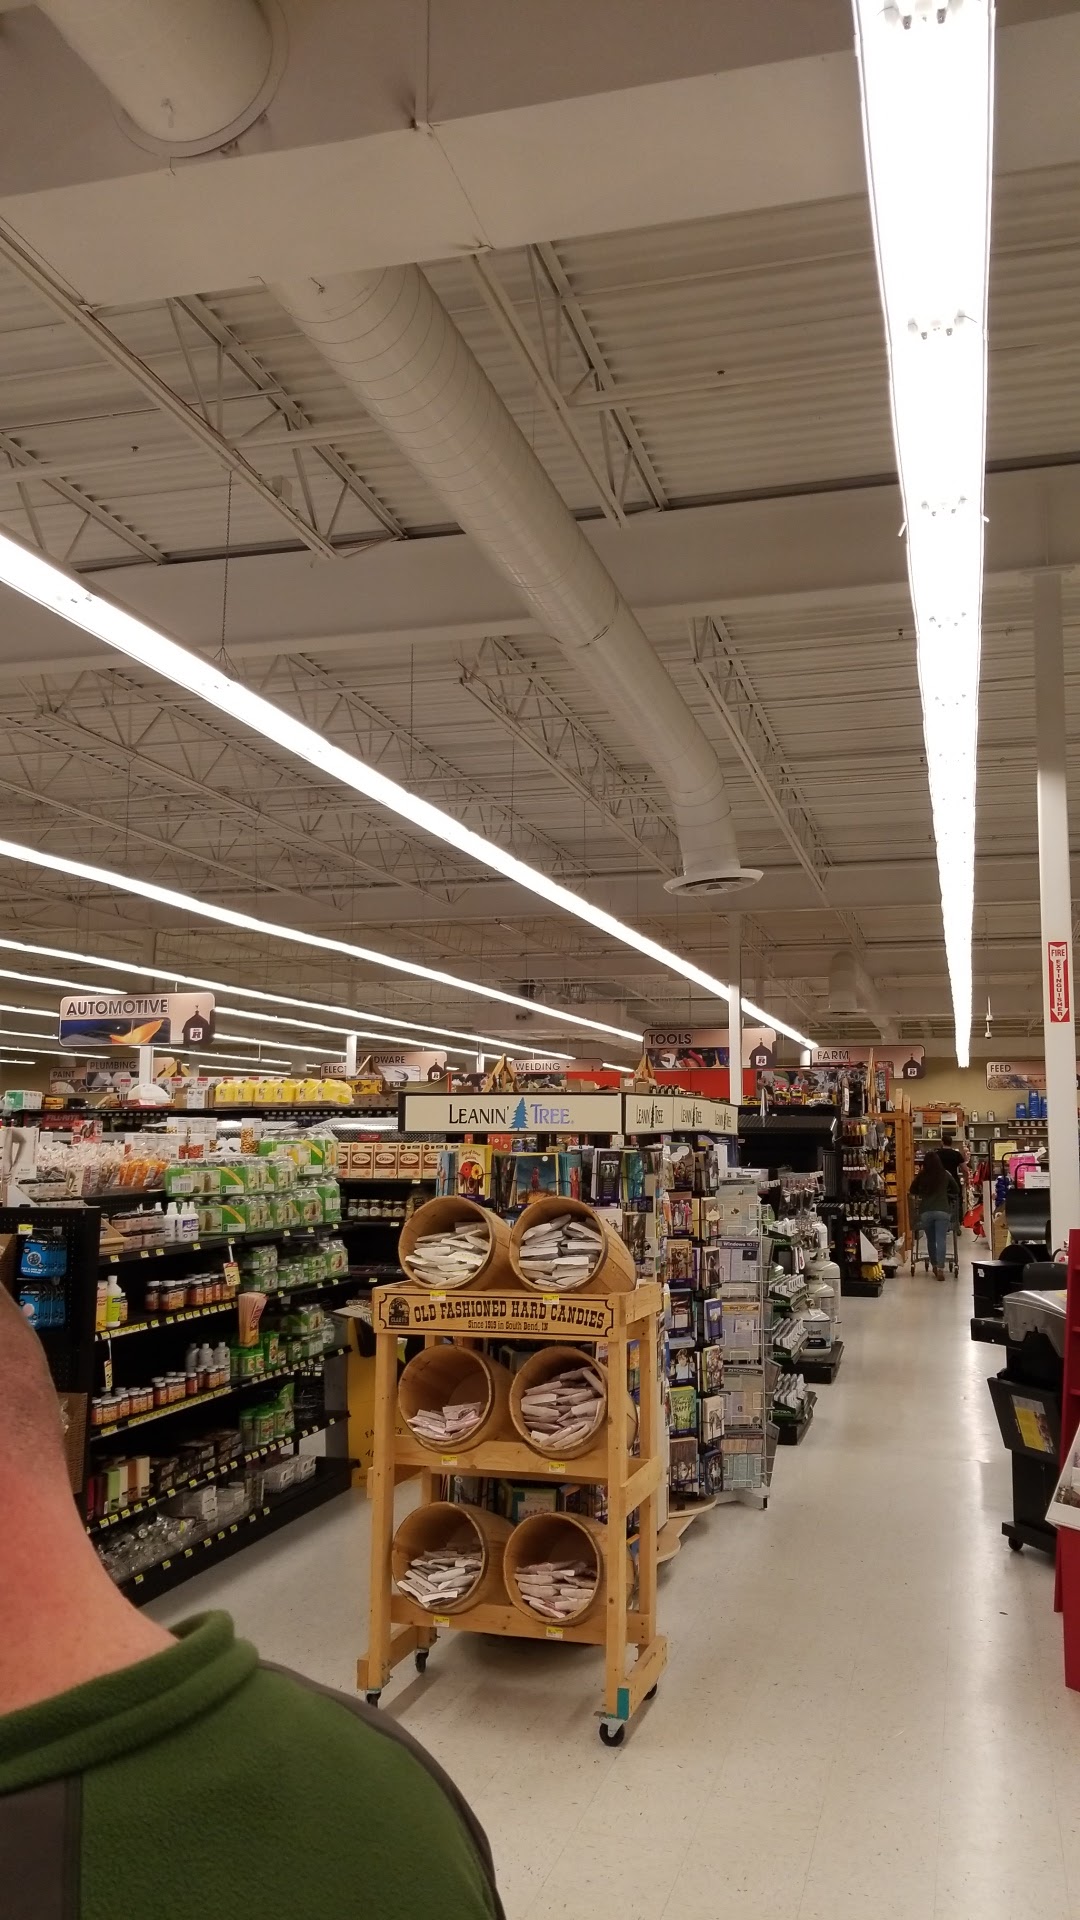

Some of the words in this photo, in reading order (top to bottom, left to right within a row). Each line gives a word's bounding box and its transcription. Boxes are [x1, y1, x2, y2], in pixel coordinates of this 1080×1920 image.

[1051, 949, 1066, 957] FIRE
[66, 999, 168, 1016] AUTOMOTIVE
[649, 1033, 692, 1045] TOOLS
[356, 1055, 406, 1064] HADWARE
[817, 1050, 850, 1061] FARM
[90, 1061, 137, 1070] PLUMBING
[515, 1062, 561, 1071] WELDING
[990, 1064, 1012, 1073] FEED
[449, 1103, 510, 1124] LEANIN'
[414, 1304, 436, 1322] OLD
[440, 1300, 506, 1319] FASHIONED
[512, 1300, 546, 1319] HARD
[551, 1304, 605, 1329] CANDIES
[468, 1320, 484, 1329] Since
[498, 1321, 505, 1330] in
[506, 1321, 522, 1330] South
[523, 1322, 540, 1332] Bend,
